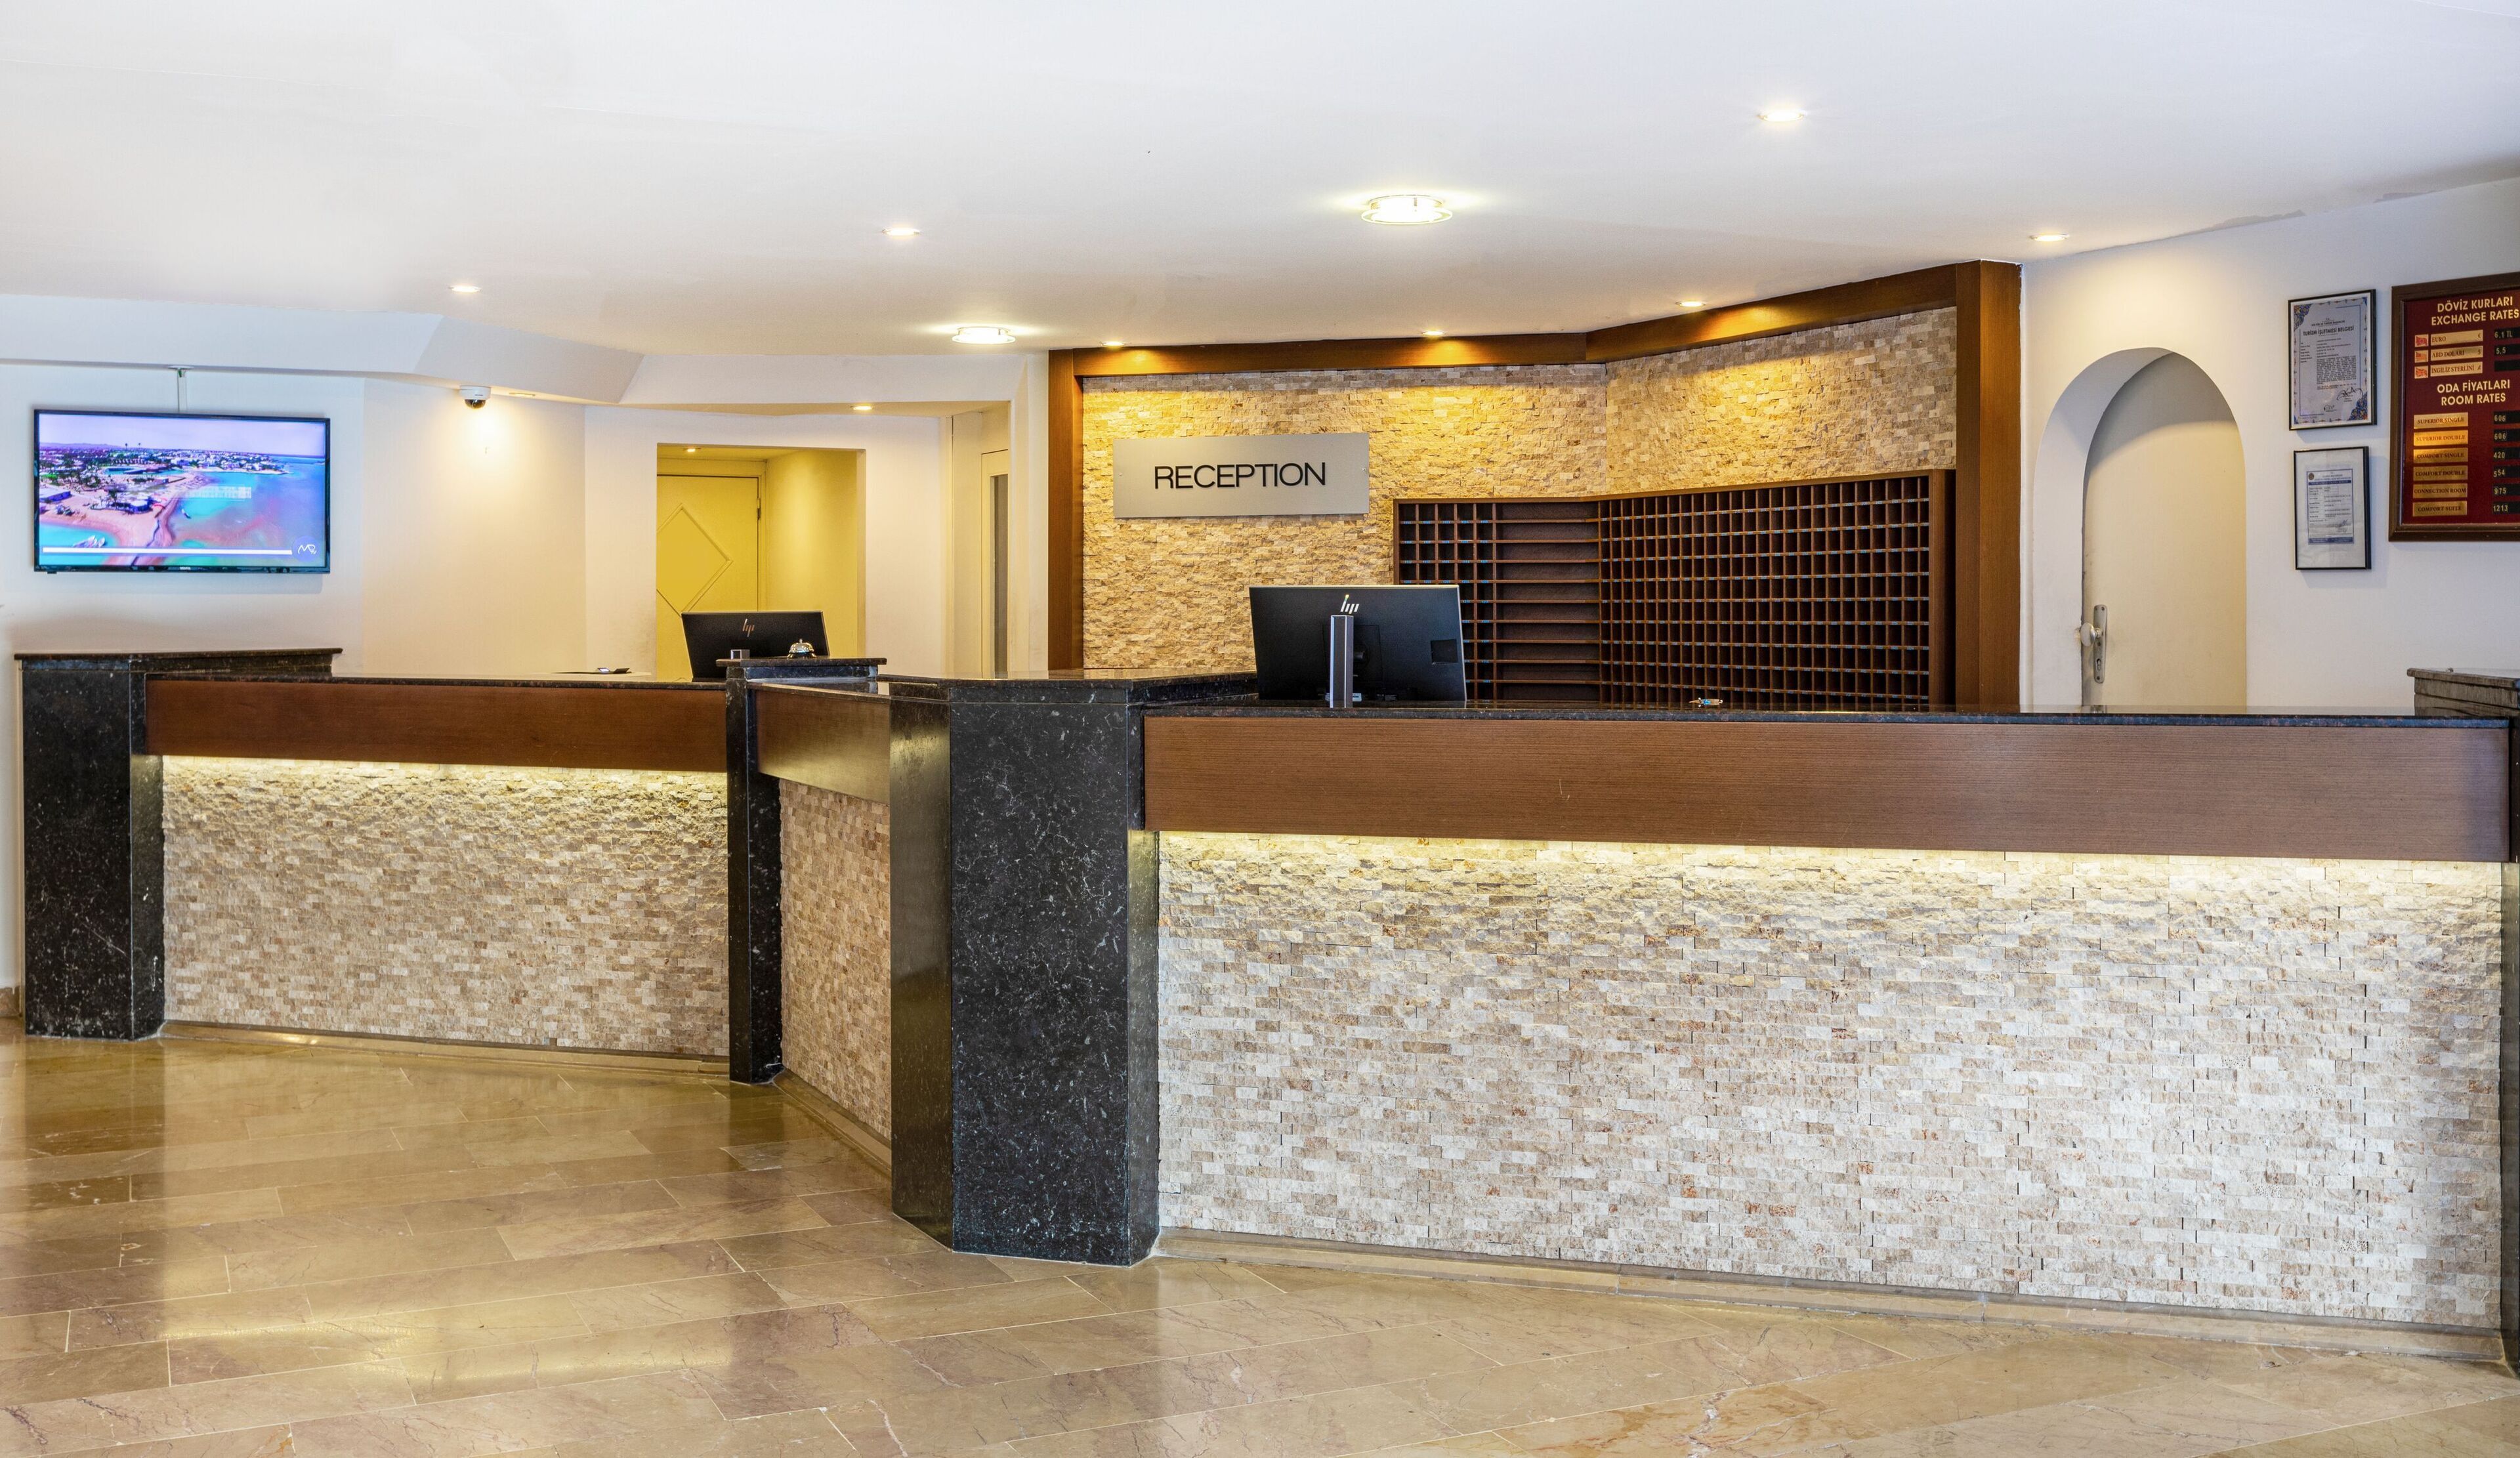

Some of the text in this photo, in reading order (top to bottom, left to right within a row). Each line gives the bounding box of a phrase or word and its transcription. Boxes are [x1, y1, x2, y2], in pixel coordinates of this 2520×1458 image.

[2437, 297, 2513, 312] DÖVİZ KURLARI
[2431, 309, 2519, 325] EXCHANGE RATES
[2437, 379, 2510, 393] ODA FİYATLARI
[2441, 393, 2506, 406] ROOM RATES
[1154, 462, 1326, 489] RECEPTION
[2494, 469, 2505, 478] 554
[1340, 594, 1360, 614] hp
[743, 618, 755, 637] hp
